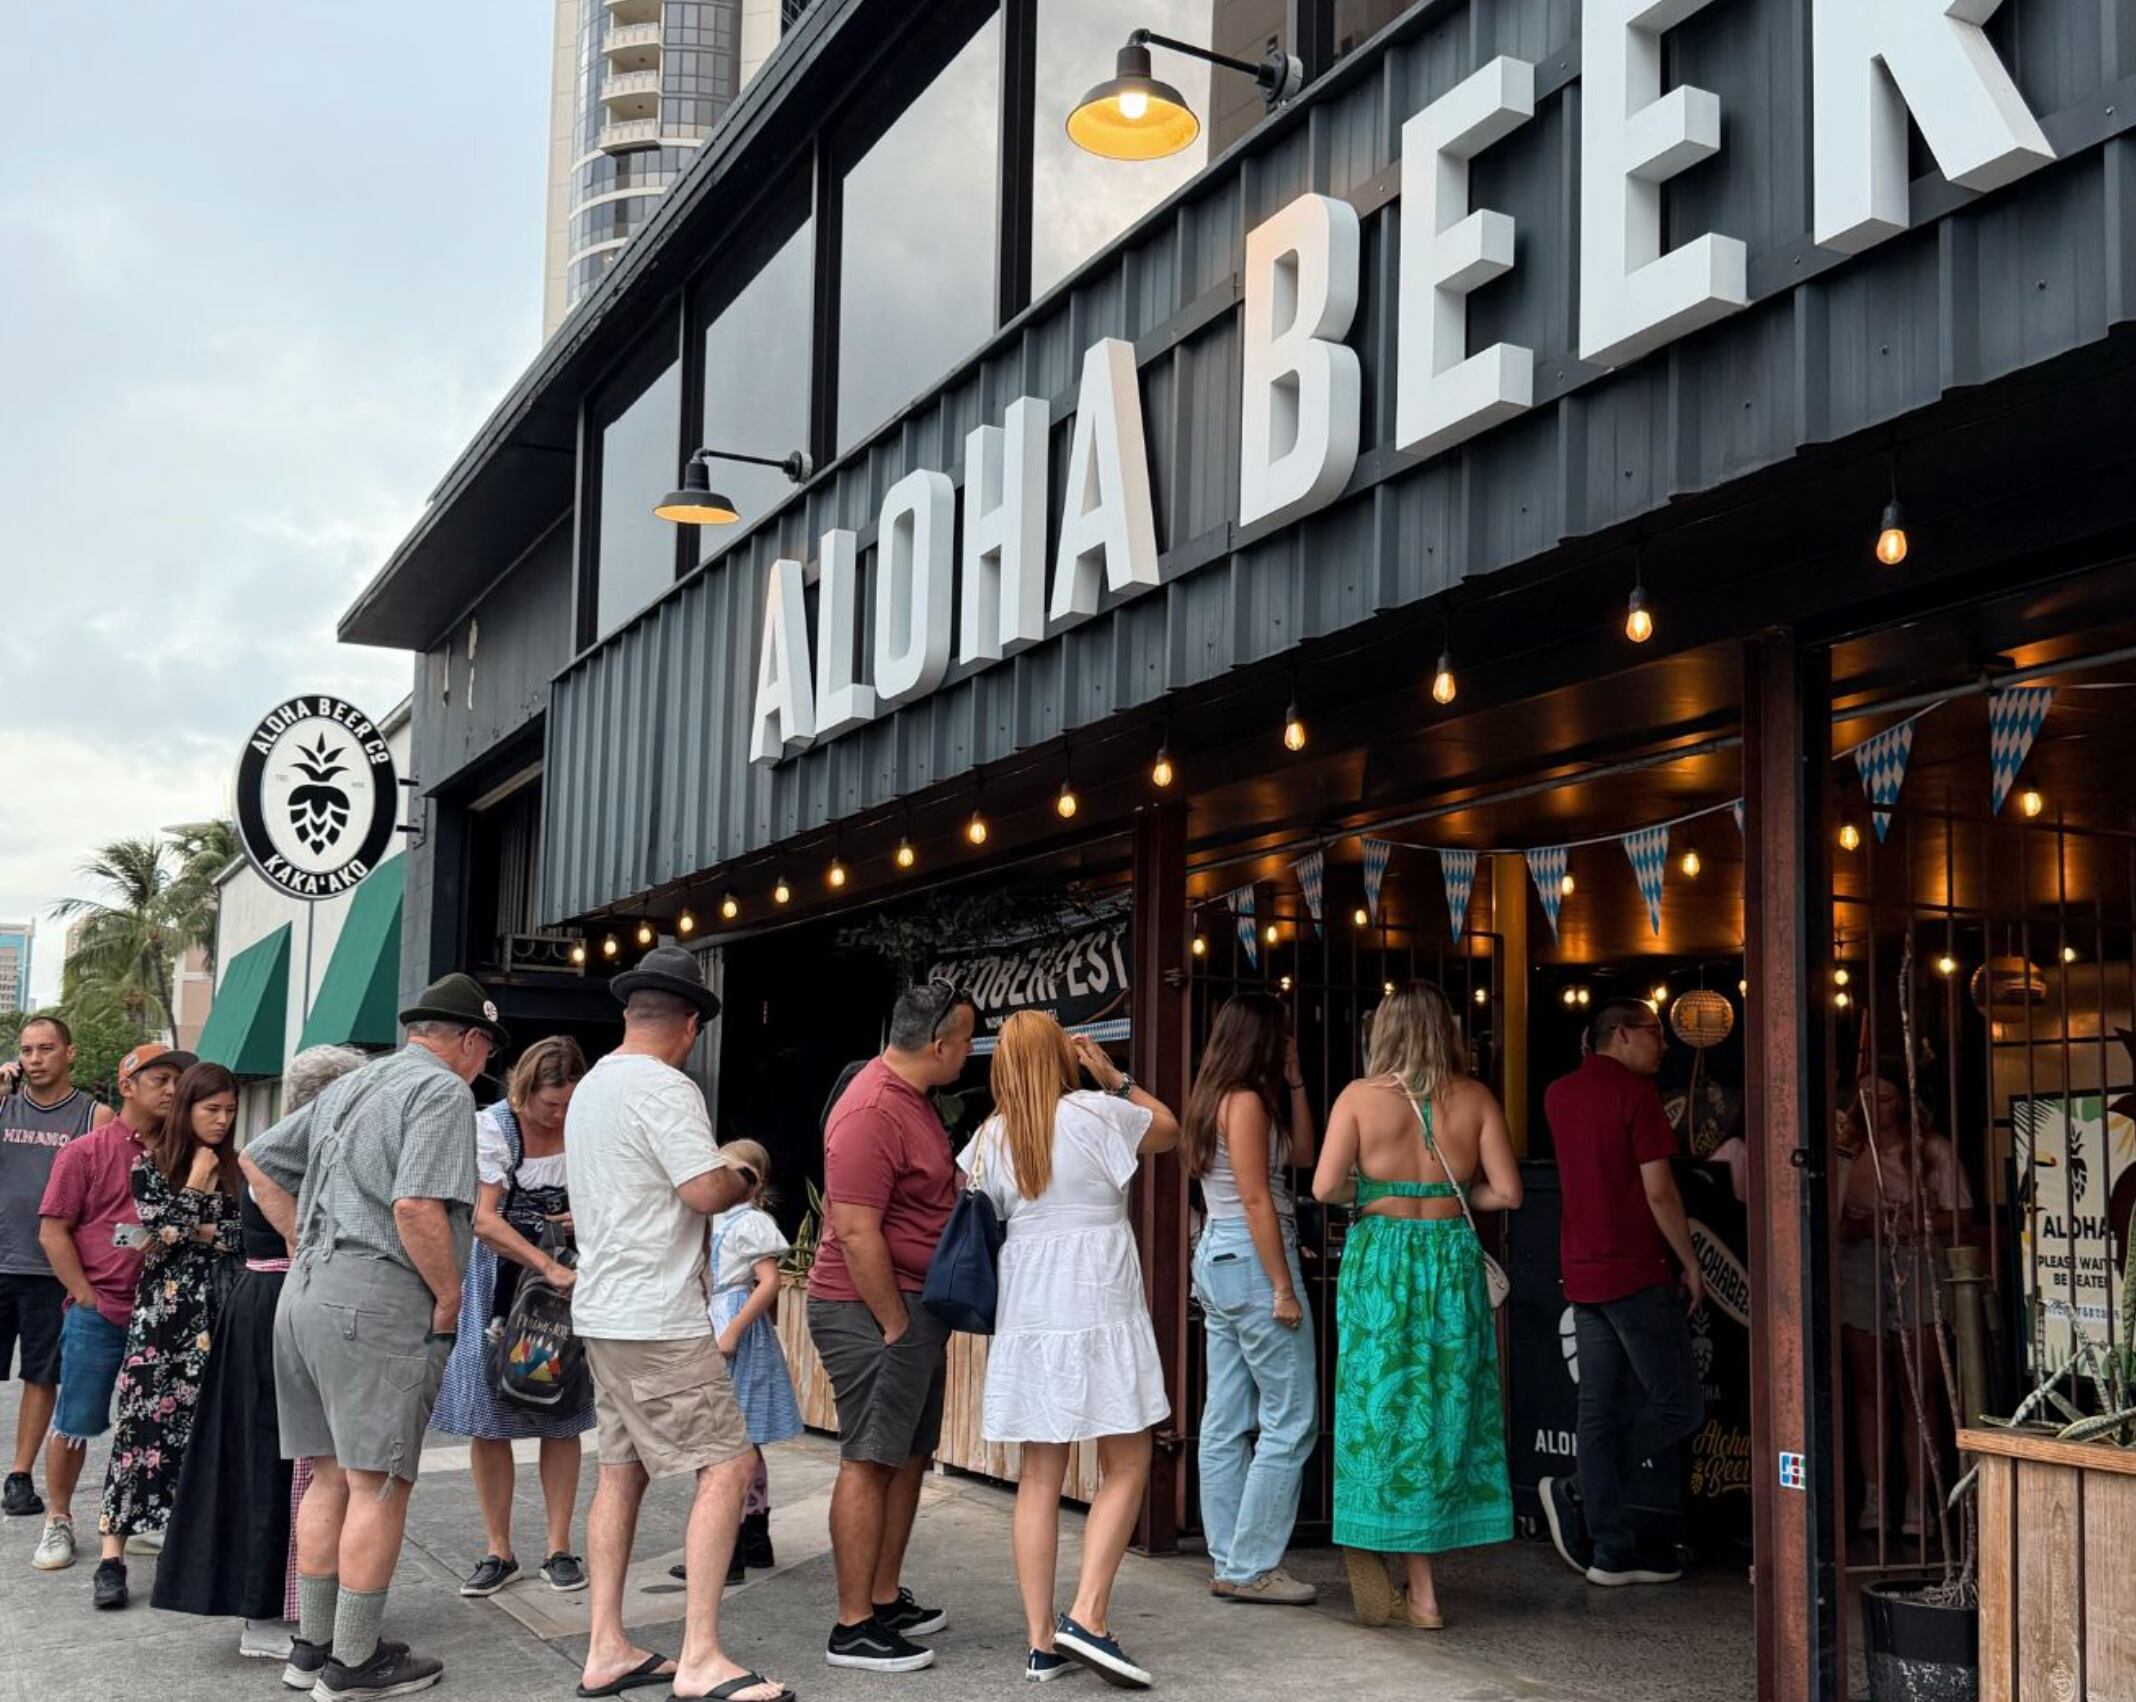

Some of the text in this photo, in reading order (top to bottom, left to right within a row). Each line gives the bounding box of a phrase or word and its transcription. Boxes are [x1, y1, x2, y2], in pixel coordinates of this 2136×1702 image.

[749, 337, 1161, 769] ALOHA
[250, 699, 312, 755] ALOHA
[318, 697, 372, 738] BEER
[2053, 1272, 2068, 1286] BE
